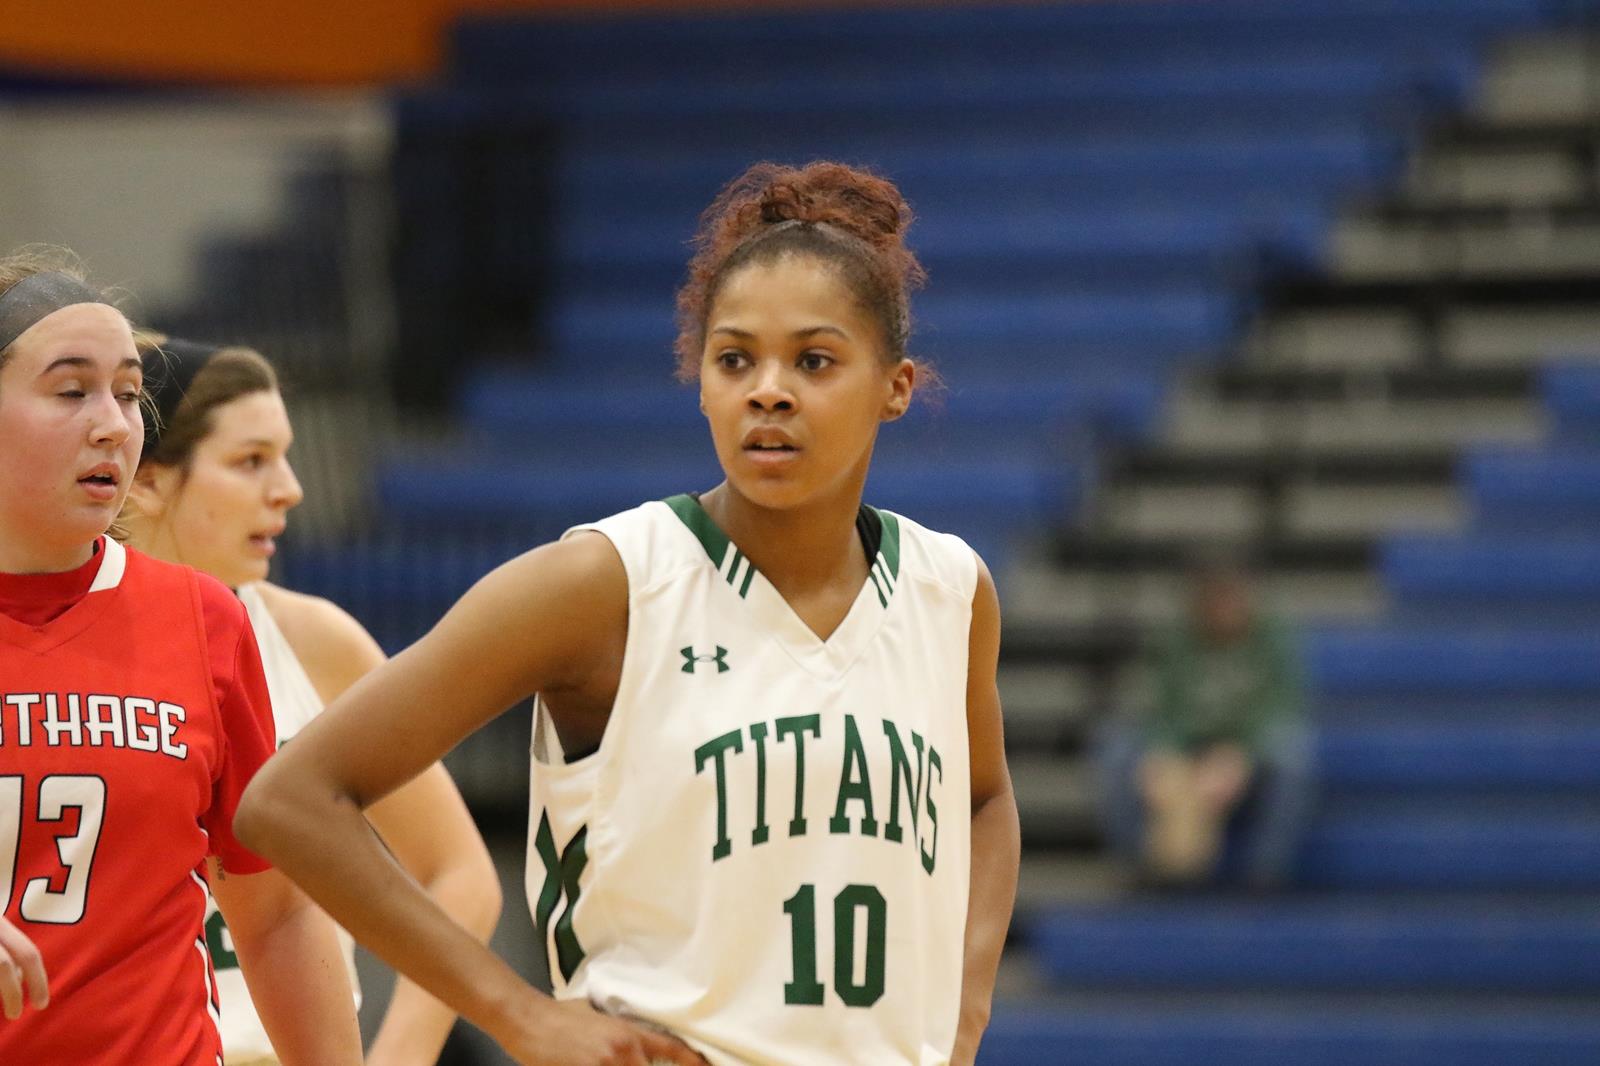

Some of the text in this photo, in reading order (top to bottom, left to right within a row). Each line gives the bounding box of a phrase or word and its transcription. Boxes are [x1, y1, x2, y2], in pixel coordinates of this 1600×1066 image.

[0, 693, 188, 760] THAGE
[694, 713, 942, 876] TITANS
[783, 884, 887, 1008] 10
